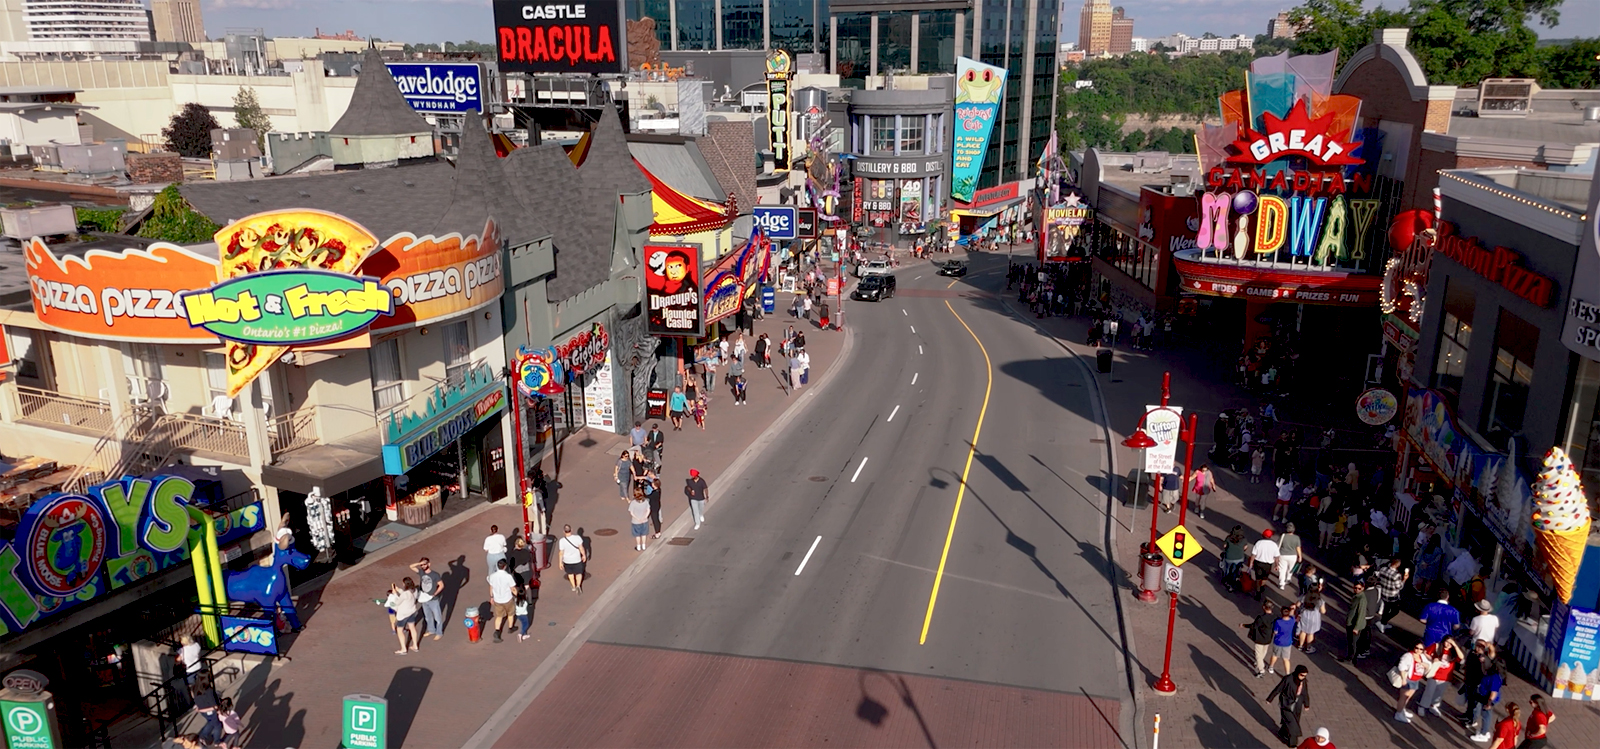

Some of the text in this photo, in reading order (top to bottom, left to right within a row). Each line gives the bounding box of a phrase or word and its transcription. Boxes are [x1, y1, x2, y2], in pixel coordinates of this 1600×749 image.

[522, 5, 586, 20] CASTLE
[499, 25, 615, 66] DRACULA
[387, 66, 477, 103] avelodge
[412, 101, 456, 109] WYNDHAM
[771, 93, 786, 160] PUTT
[1250, 129, 1343, 162] GREAT
[856, 162, 917, 173] DISTILLERY & BBQ
[903, 181, 921, 191] 4D
[1208, 167, 1373, 194] CANADIAN
[878, 202, 892, 210] BBQ
[1048, 208, 1094, 220] MOVIELAND
[1212, 283, 1359, 302] RIDES GAMES & PRIZES FUN
[183, 280, 391, 326] Hot & Fresh
[662, 307, 697, 320] Haunted
[242, 320, 343, 339] Ontario's #1 Pizza!
[666, 318, 692, 329] Castle
[571, 336, 606, 371] Giggles
[1149, 421, 1177, 433] Clifton
[1157, 430, 1173, 442] Hill
[36, 528, 63, 588] BLUE MOOSE
[6, 677, 42, 690] OPEN
[11, 735, 49, 744] PUBLIC
[350, 733, 377, 742] PUBLIC
